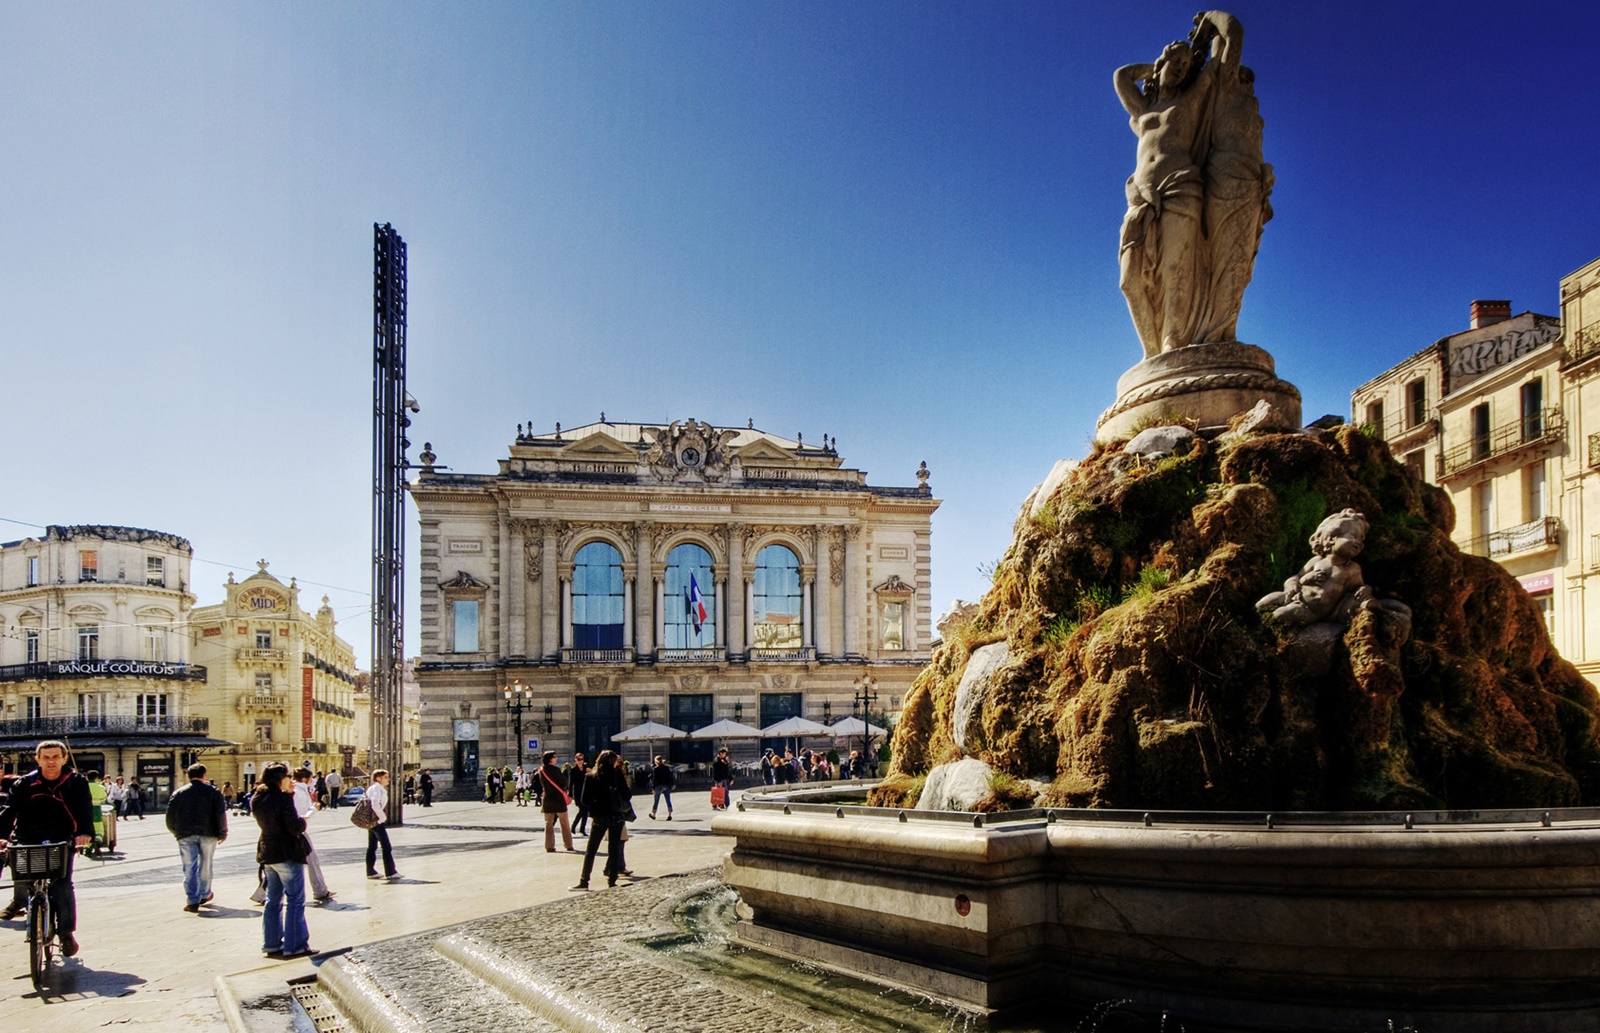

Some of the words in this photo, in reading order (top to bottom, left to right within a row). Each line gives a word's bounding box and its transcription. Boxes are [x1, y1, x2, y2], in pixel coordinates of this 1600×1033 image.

[241, 587, 262, 603] GRAND
[250, 597, 276, 609] MIDI
[58, 663, 108, 674] BANQUE
[109, 663, 175, 675] COURTOIS
